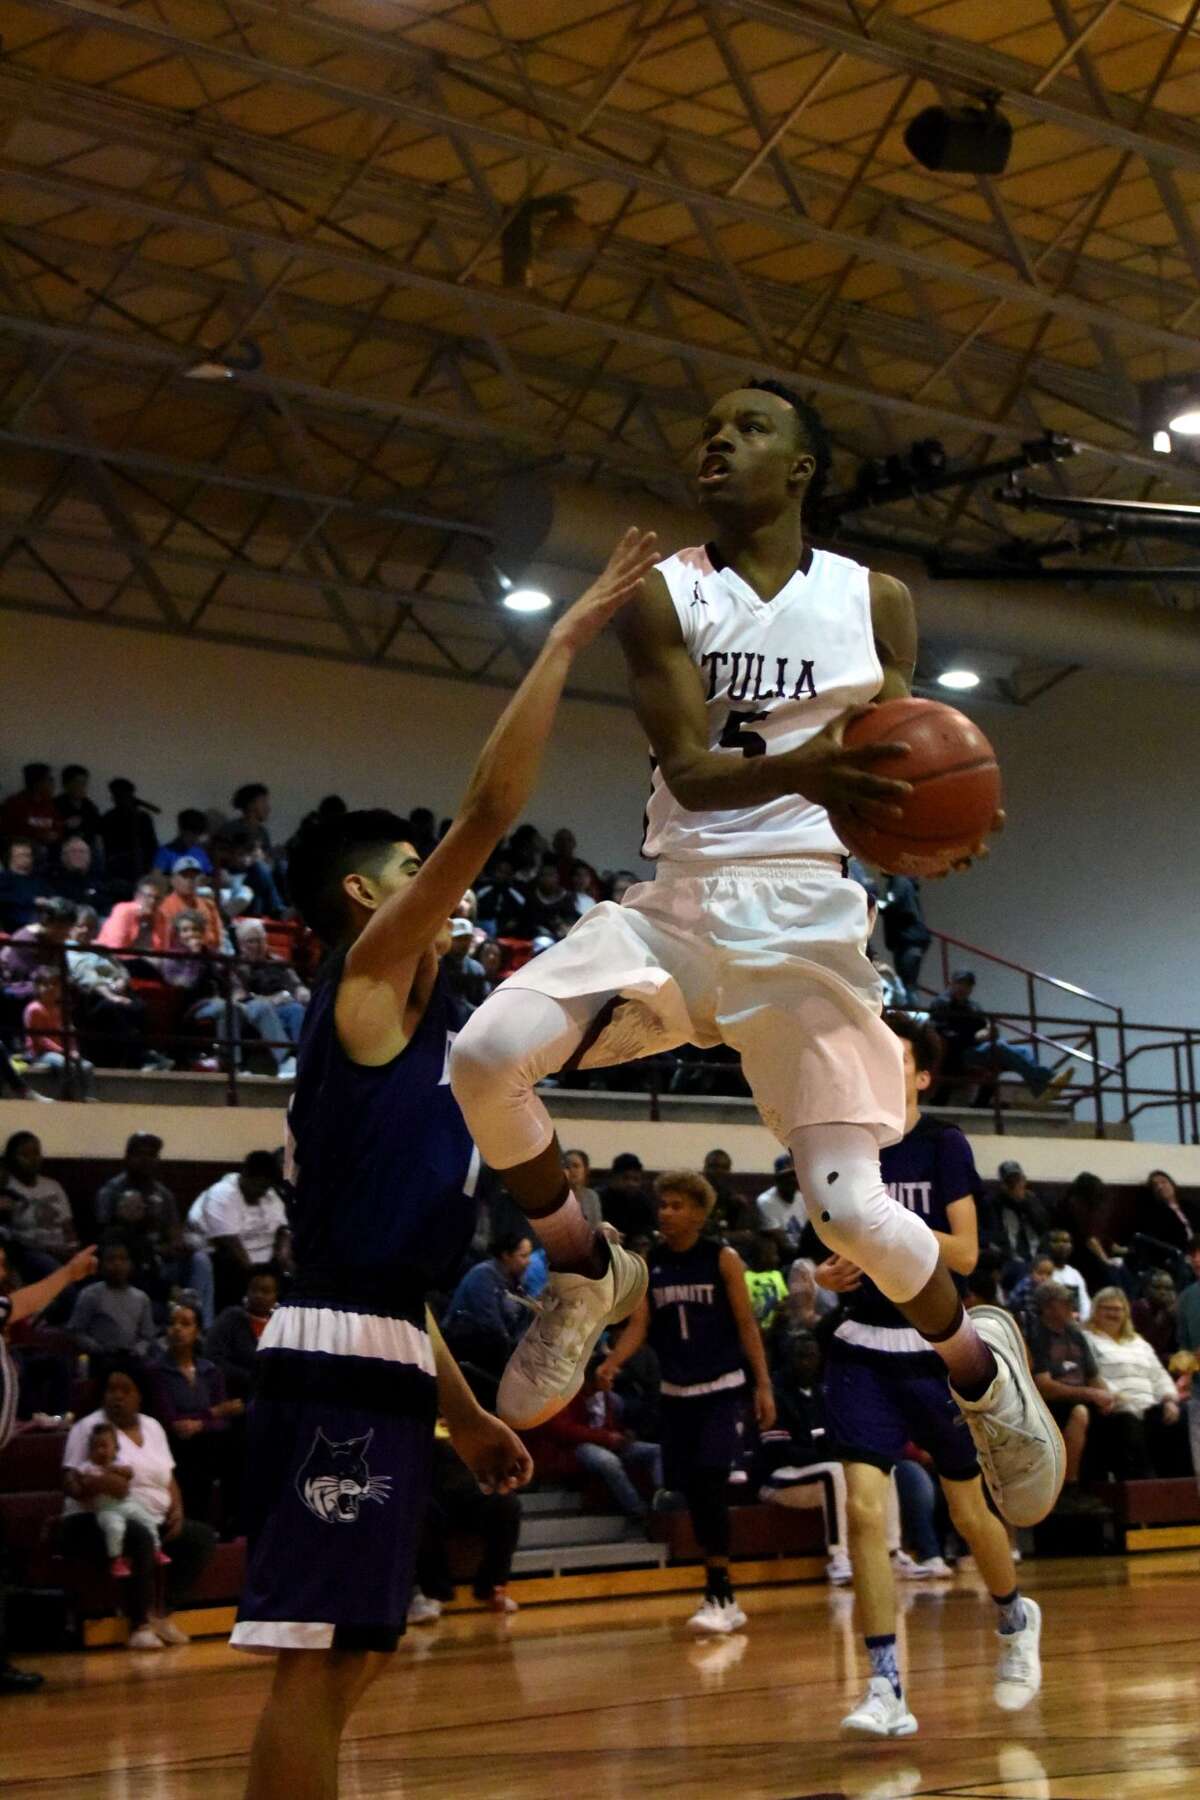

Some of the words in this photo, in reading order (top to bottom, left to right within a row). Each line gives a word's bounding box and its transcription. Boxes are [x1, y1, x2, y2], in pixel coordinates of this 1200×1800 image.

[702, 652, 817, 700] TULIA
[719, 710, 770, 758] 5
[678, 1304, 689, 1340] 1
